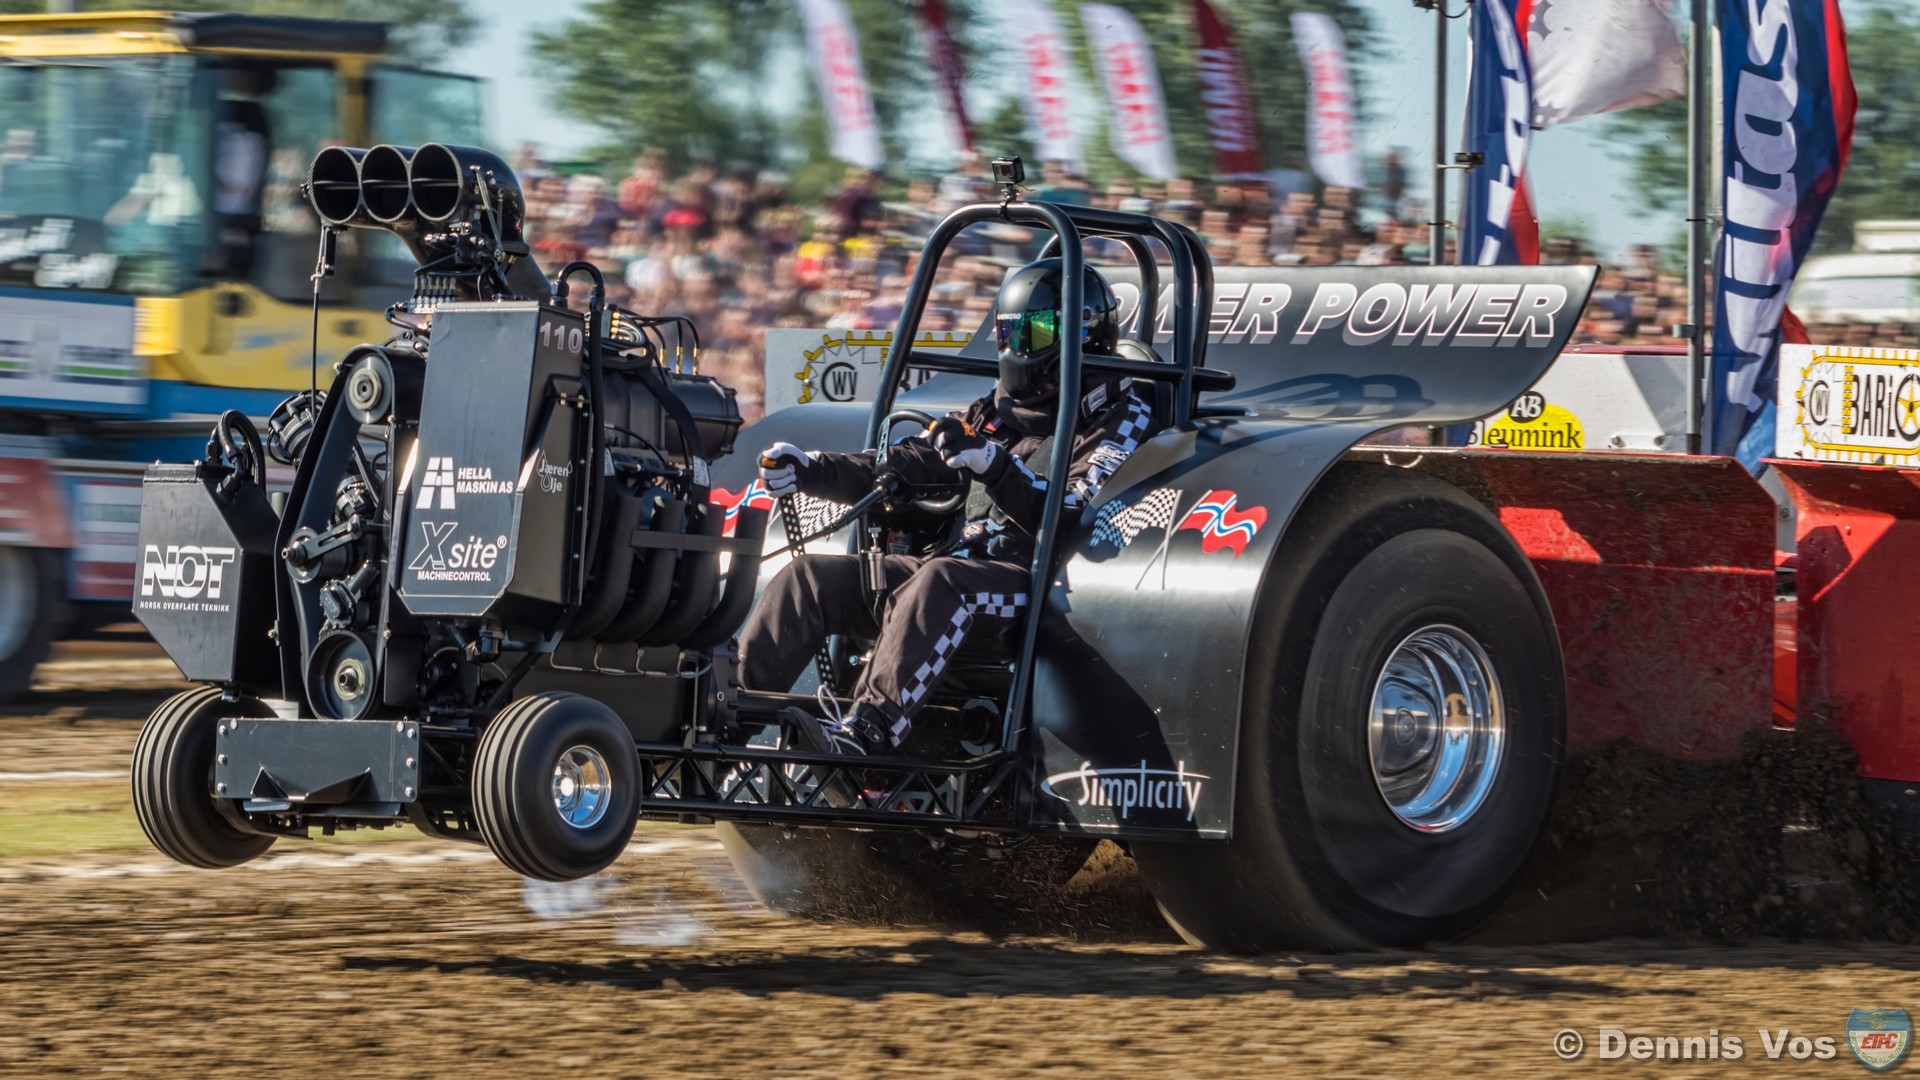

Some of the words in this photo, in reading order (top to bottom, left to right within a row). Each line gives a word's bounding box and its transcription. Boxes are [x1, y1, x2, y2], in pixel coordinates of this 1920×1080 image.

[1295, 282, 1568, 338] POWER
[540, 321, 583, 354] 110
[1510, 395, 1542, 418] AB
[457, 467, 492, 480] HELLA
[456, 481, 498, 494] MASKIN
[141, 544, 235, 599] NOT
[417, 570, 492, 582] MACHINECONTROL
[139, 601, 161, 610] NORSK
[162, 602, 199, 611] OVERFLATE
[201, 603, 230, 613] TEKNIKK
[1077, 758, 1203, 823] Simplicity
